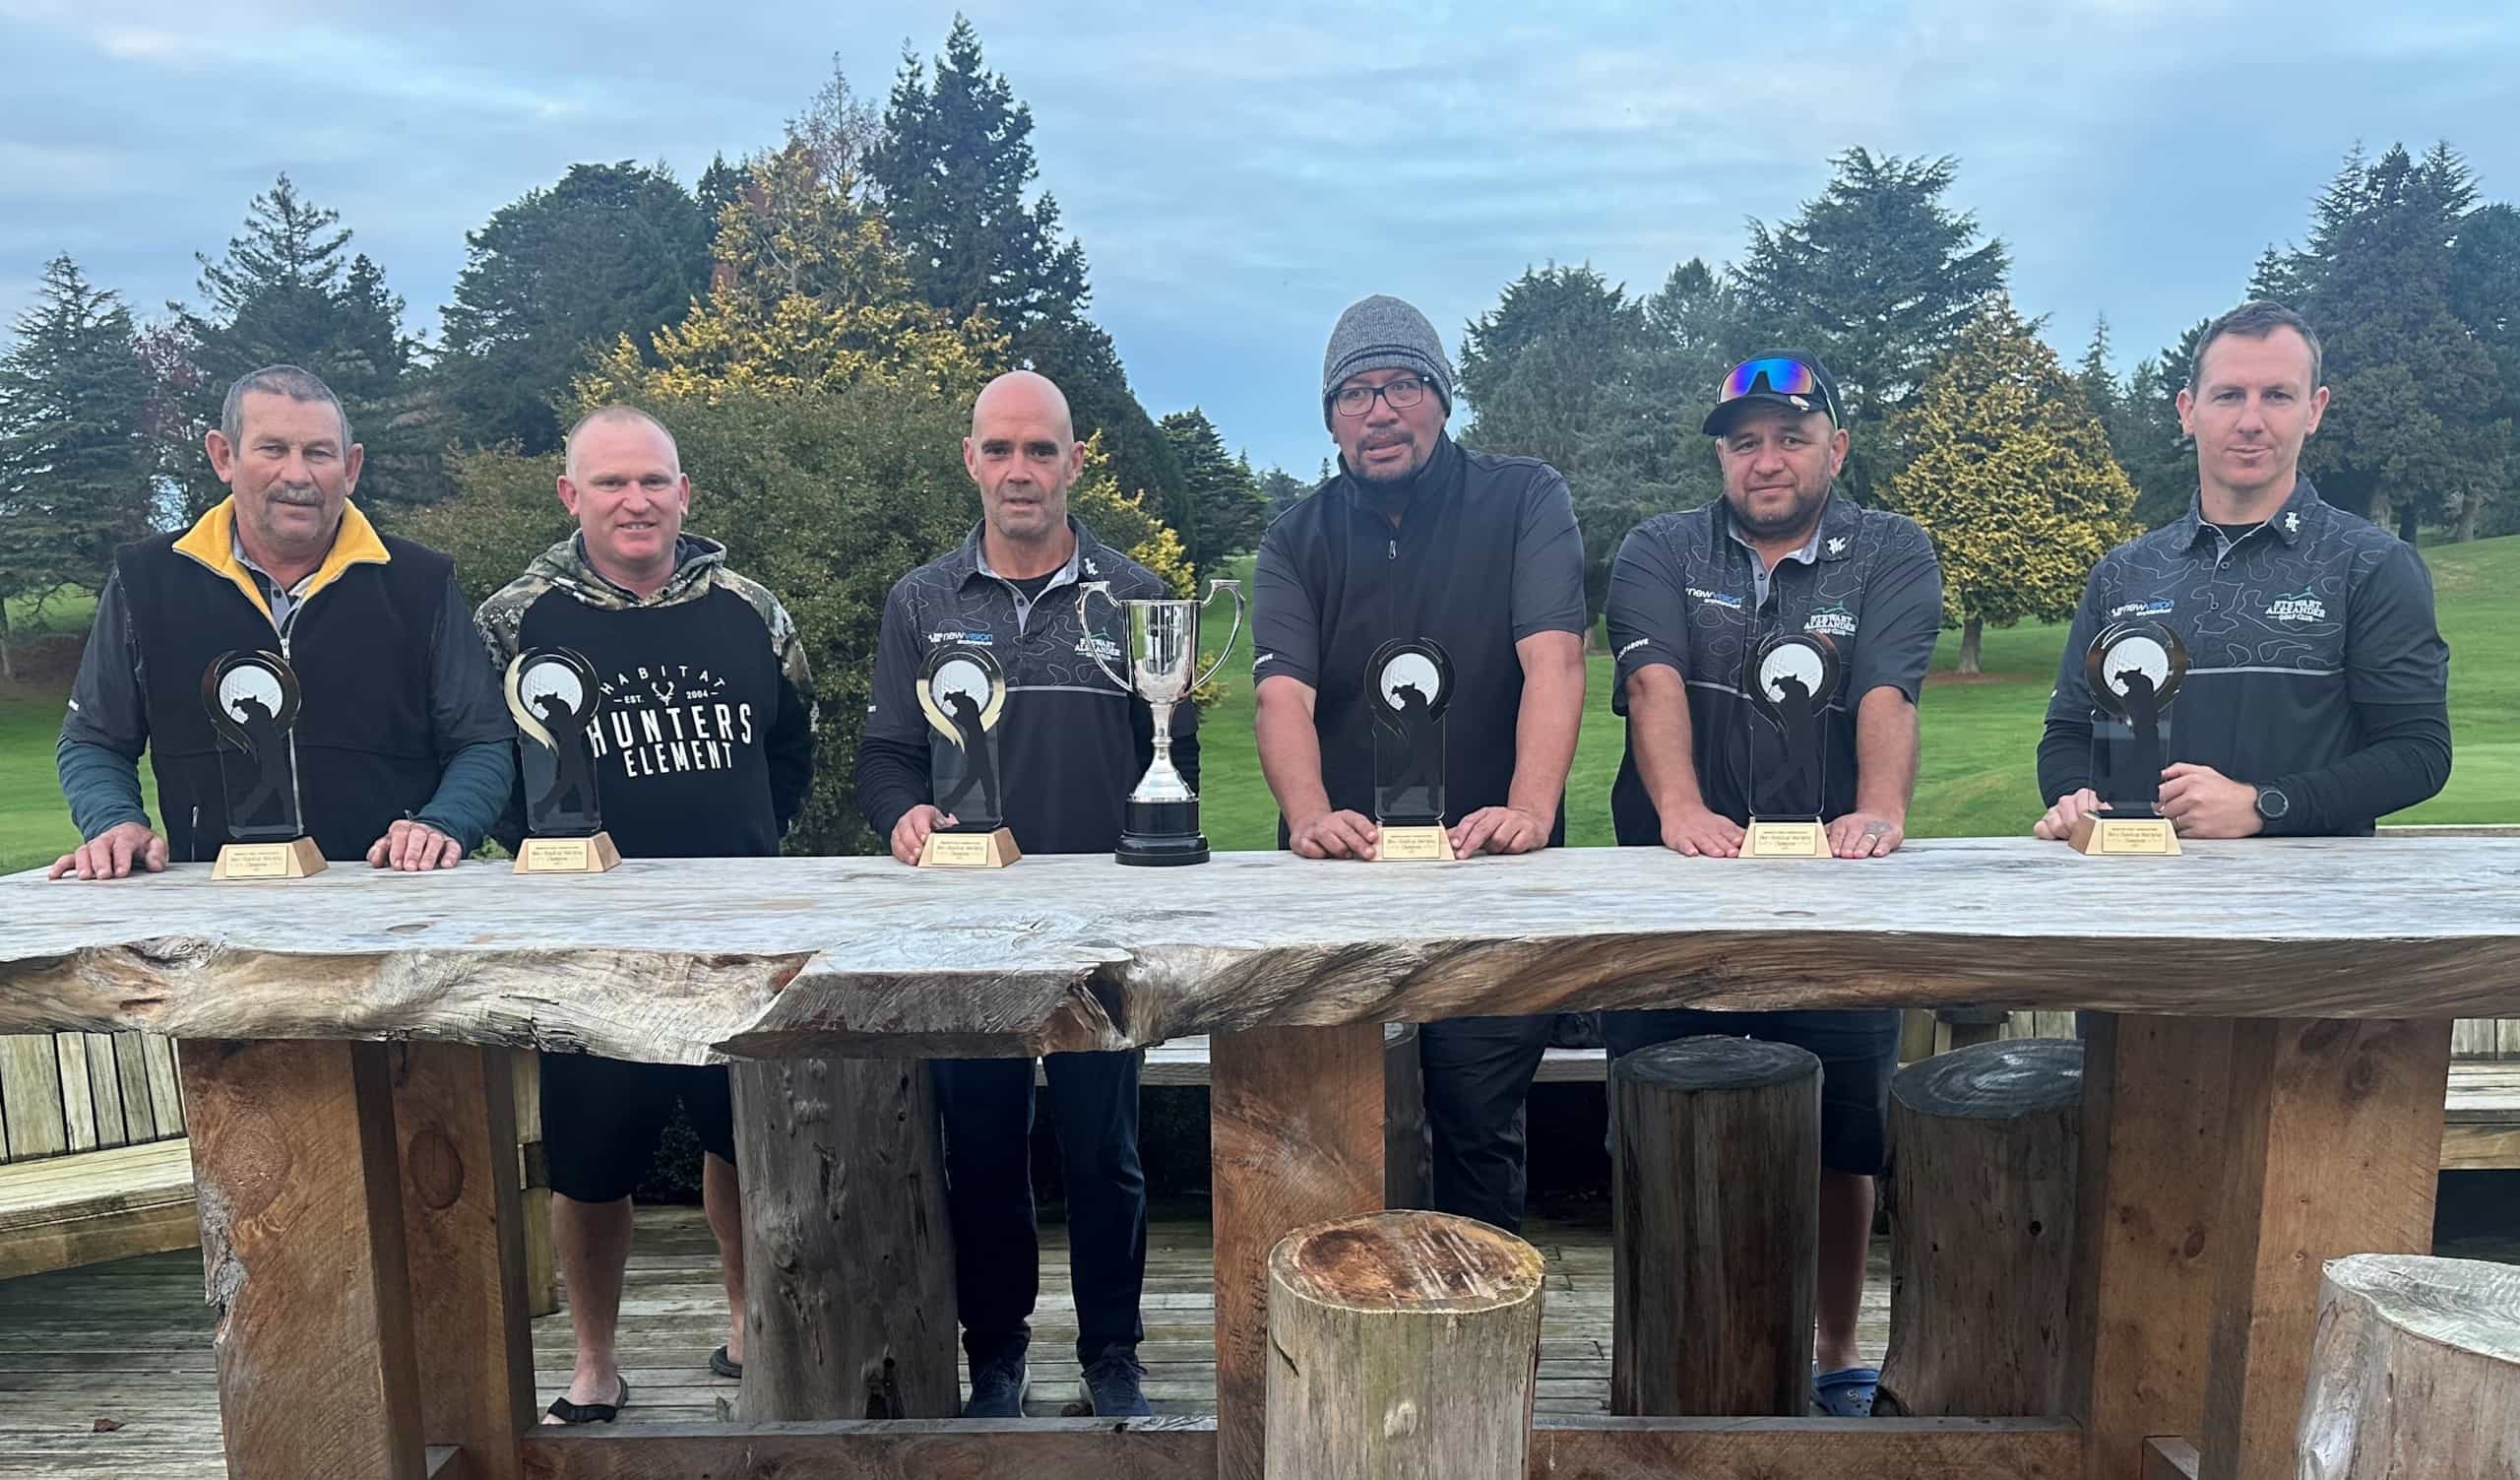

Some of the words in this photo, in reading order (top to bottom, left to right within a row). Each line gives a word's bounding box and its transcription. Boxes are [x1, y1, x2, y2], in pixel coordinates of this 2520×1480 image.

[2265, 607, 2325, 617] ALEXANDER
[2274, 600, 2322, 610] STEWART
[599, 665, 725, 695] HABITAT
[624, 695, 645, 704] EST.
[685, 690, 709, 700] 2004
[586, 703, 752, 758] HUNTERS
[623, 740, 732, 777] ELEMENT
